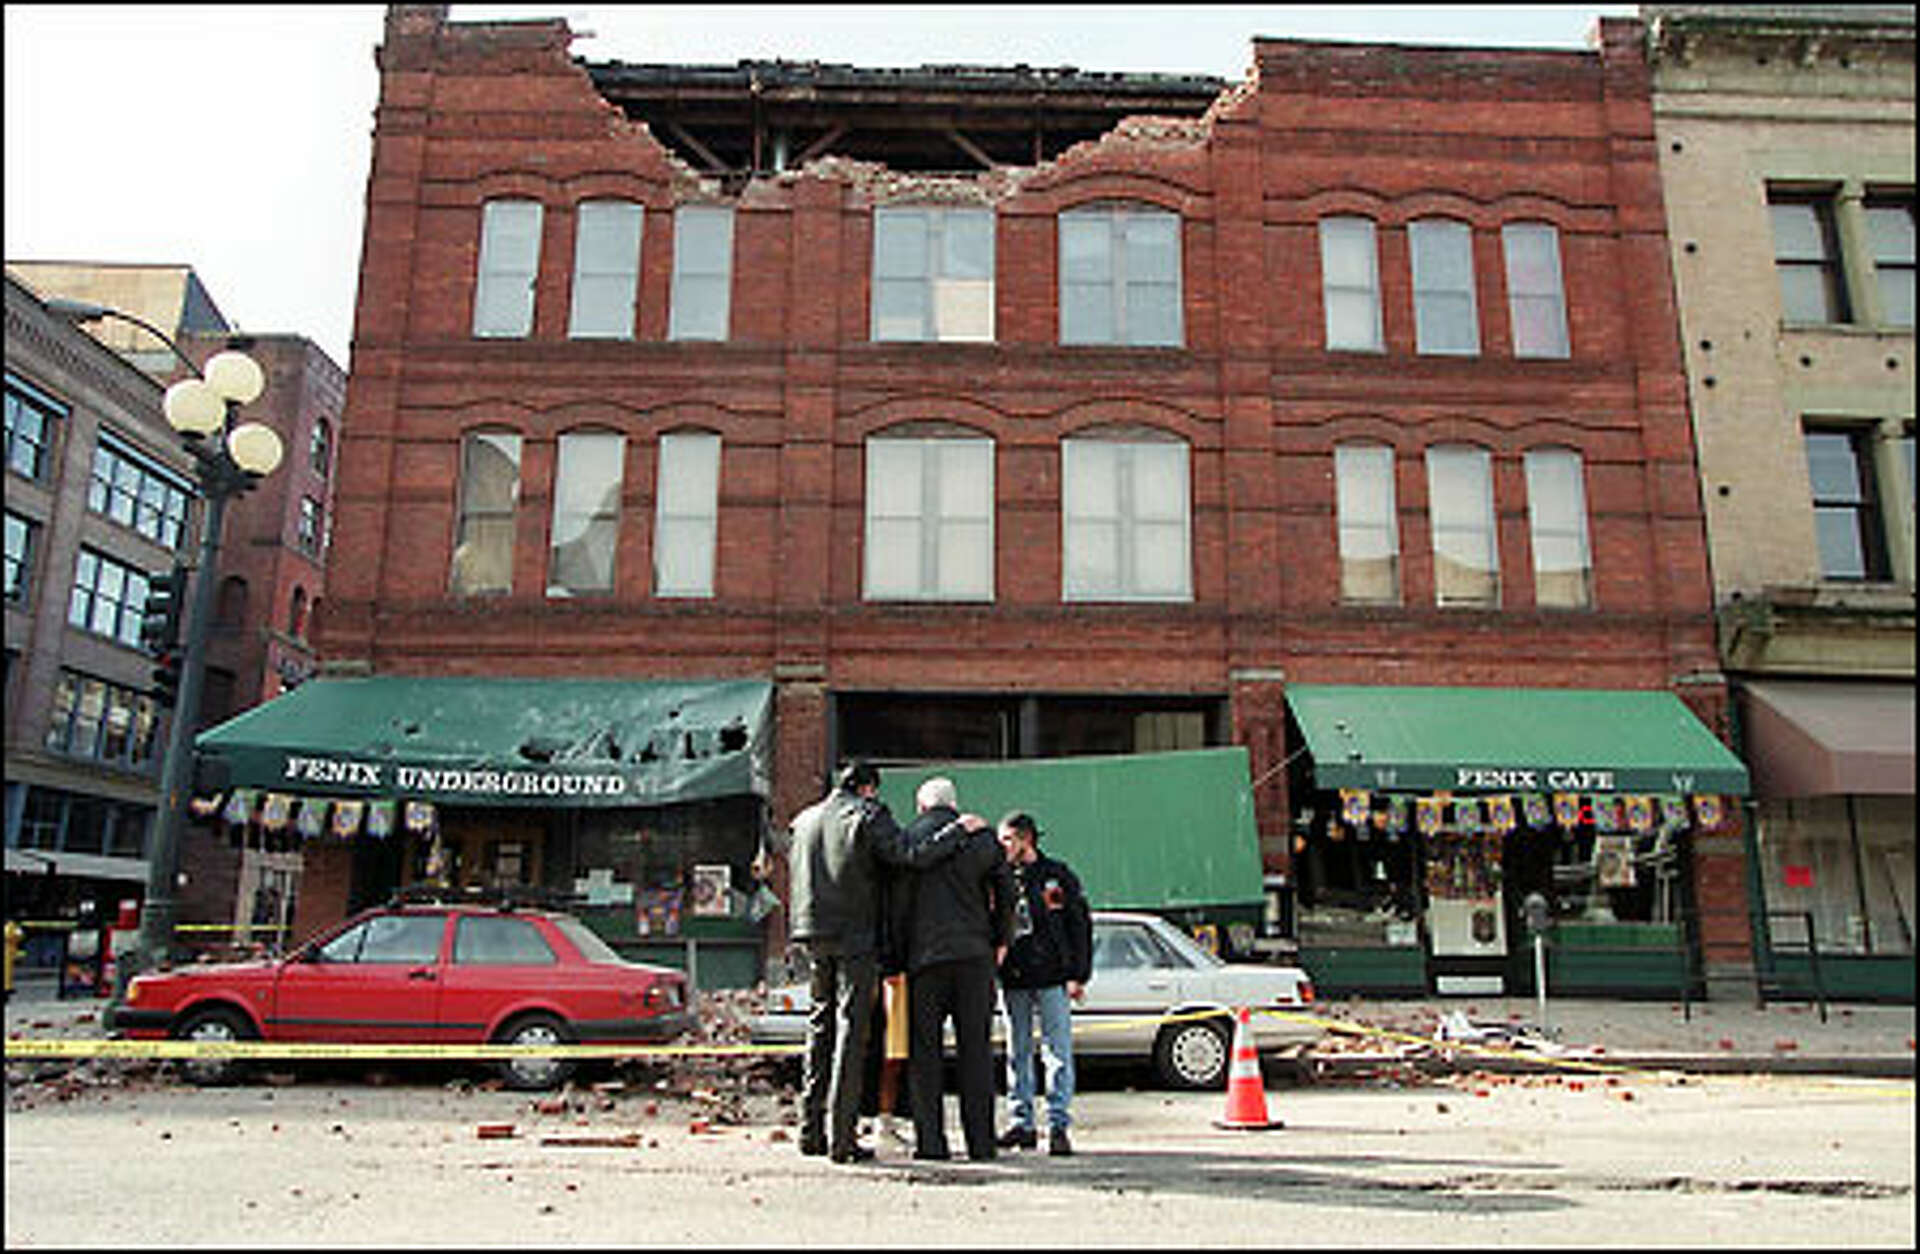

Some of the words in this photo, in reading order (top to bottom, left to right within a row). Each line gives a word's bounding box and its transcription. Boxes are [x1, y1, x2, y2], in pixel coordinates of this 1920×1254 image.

[285, 757, 382, 786] FENIX
[399, 766, 626, 795] UNDERGROUND
[1457, 769, 1537, 788] FENIX
[1548, 770, 1615, 789] CAFE
